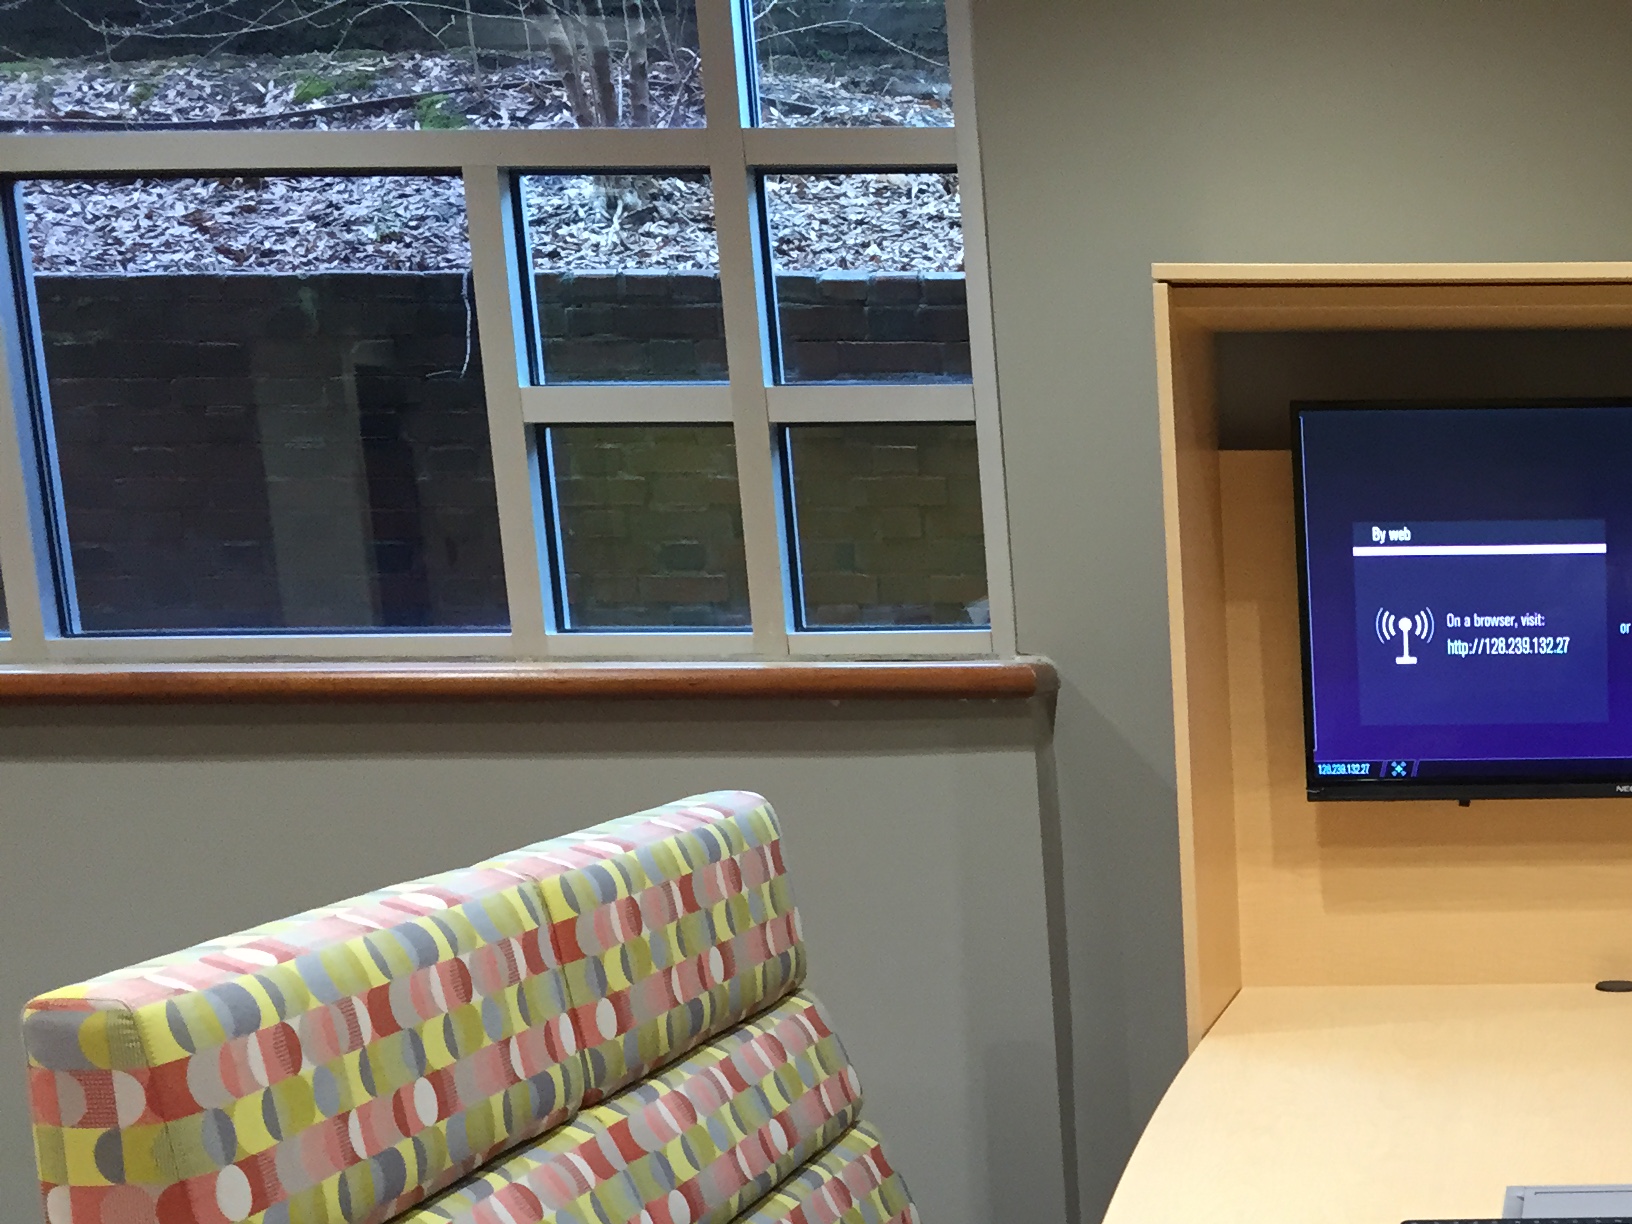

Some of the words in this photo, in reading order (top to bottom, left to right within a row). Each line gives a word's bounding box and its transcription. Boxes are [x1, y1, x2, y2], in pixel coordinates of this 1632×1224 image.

[1371, 526, 1387, 545] By
[1388, 526, 1412, 542] web
[1446, 613, 1461, 628] On
[1463, 616, 1471, 627] a
[1473, 613, 1519, 629] browser,
[1520, 612, 1546, 627] visit:
[1619, 622, 1632, 635] or
[1446, 636, 1571, 658] http://128.239.132.27
